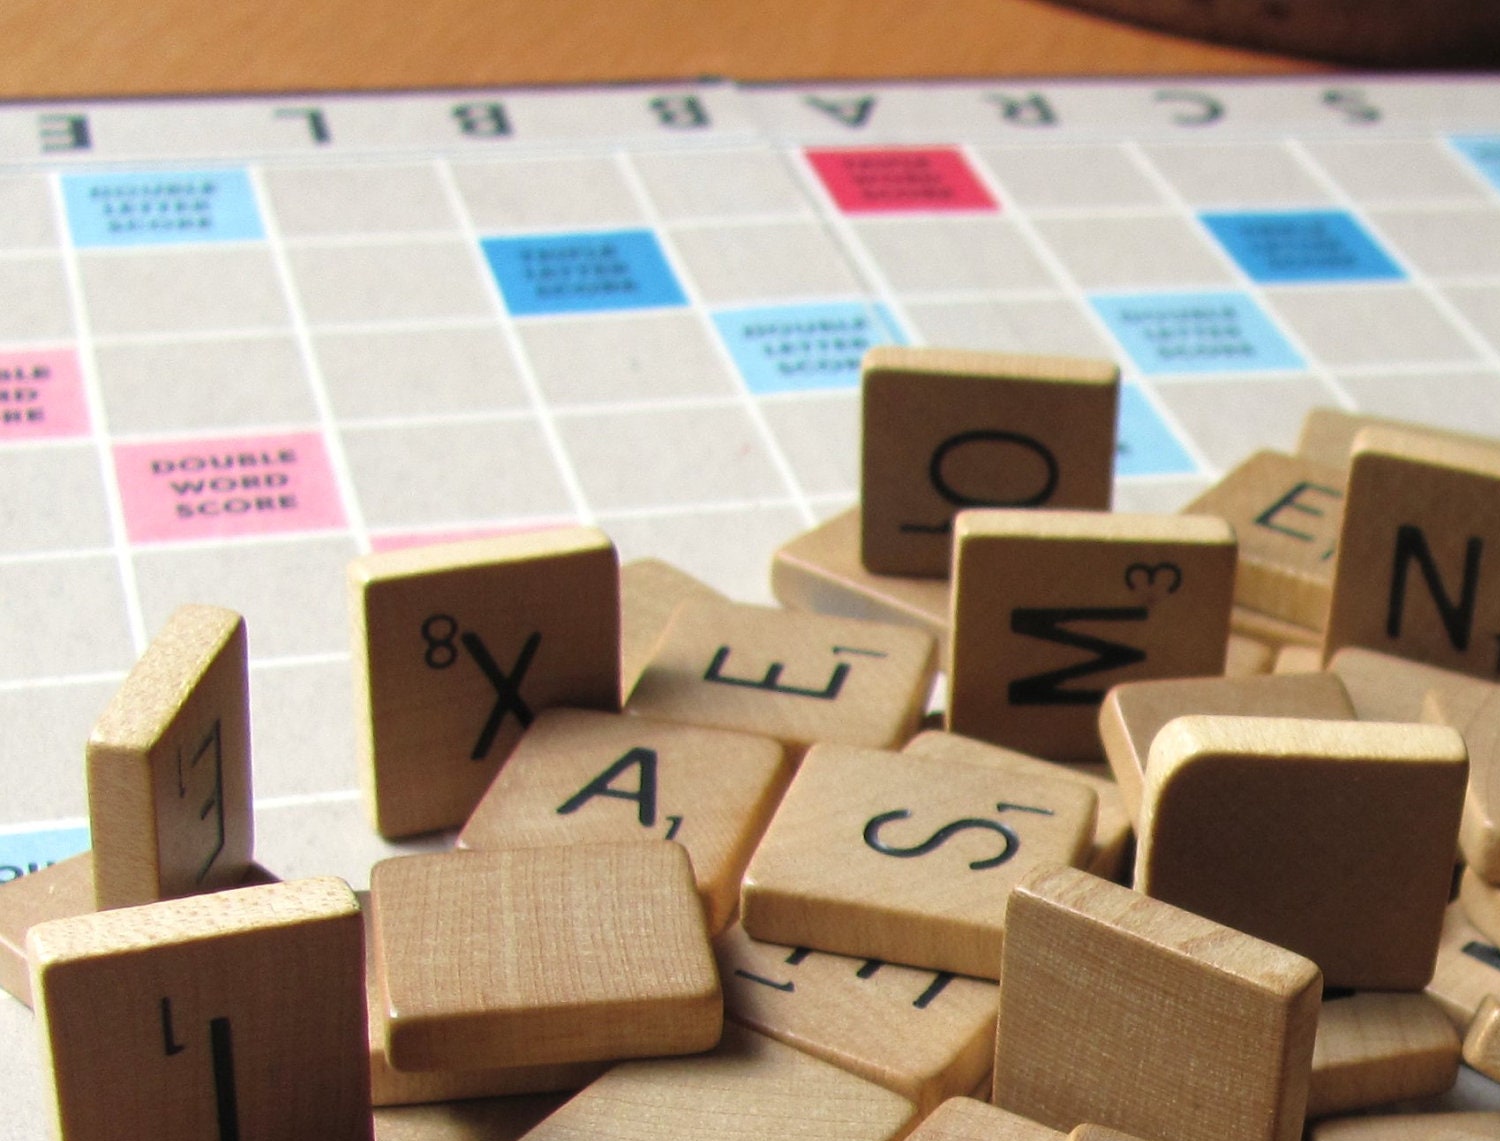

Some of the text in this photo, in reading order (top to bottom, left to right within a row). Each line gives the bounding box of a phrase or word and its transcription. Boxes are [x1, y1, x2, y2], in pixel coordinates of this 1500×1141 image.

[151, 449, 297, 475] DOUBLE
[171, 474, 289, 495] WORD
[175, 496, 297, 518] SCORE
[1387, 525, 1484, 652] N
[704, 645, 852, 702] E
[1009, 606, 1150, 706] M
[462, 631, 544, 761] X
[556, 746, 659, 828] A
[862, 808, 1021, 871] S
